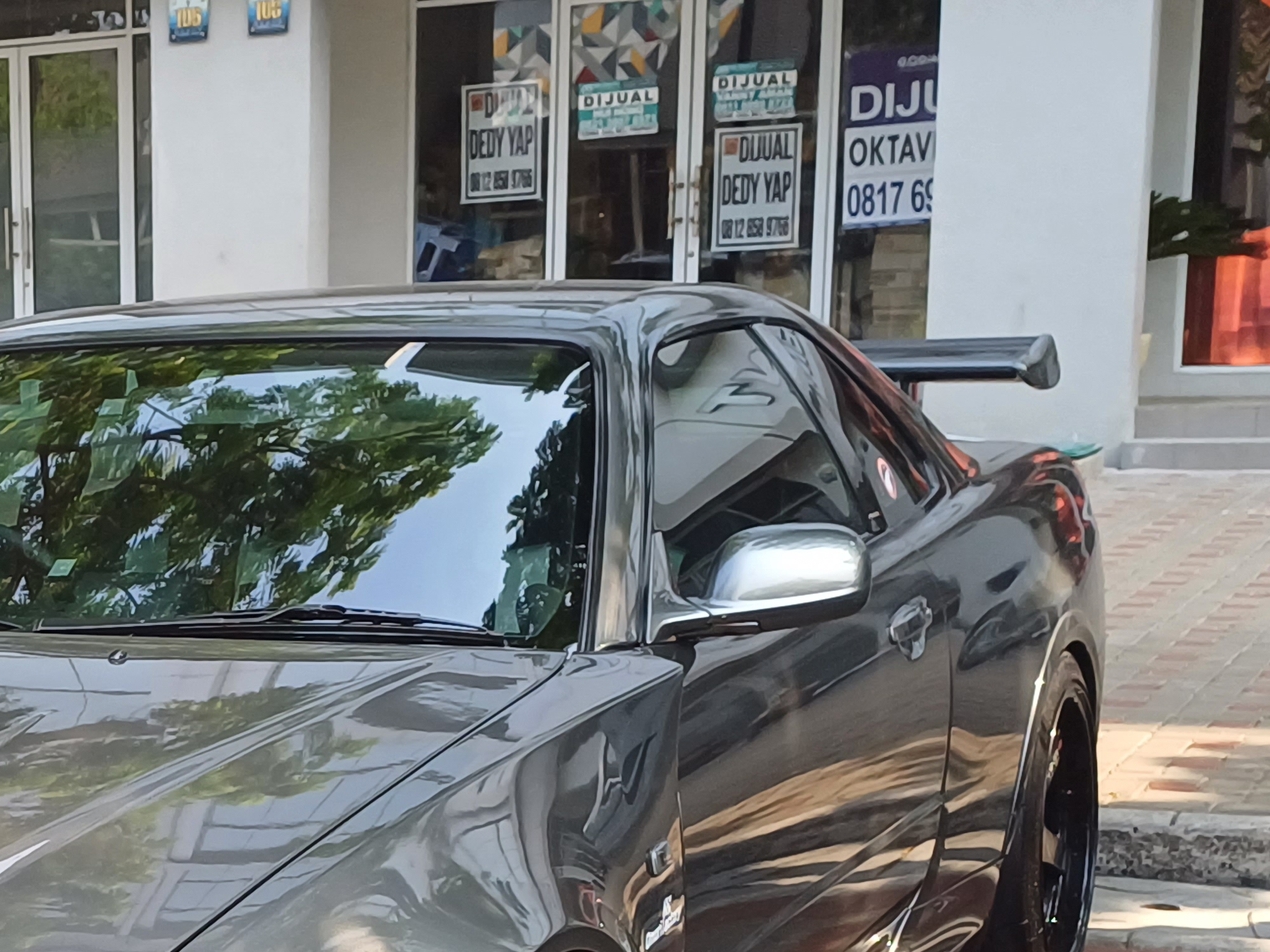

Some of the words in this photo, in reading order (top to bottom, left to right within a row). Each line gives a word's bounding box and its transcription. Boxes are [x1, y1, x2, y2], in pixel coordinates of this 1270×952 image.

[718, 72, 791, 89] DIJUAL
[485, 87, 534, 118] DIUL
[584, 90, 653, 107] DIJUAL
[469, 127, 505, 160] DEDY
[508, 125, 534, 156] YAP
[739, 132, 793, 163] DIJUAL
[722, 172, 761, 206] DEDY
[764, 171, 792, 203] YAP
[847, 181, 904, 216] 0817
